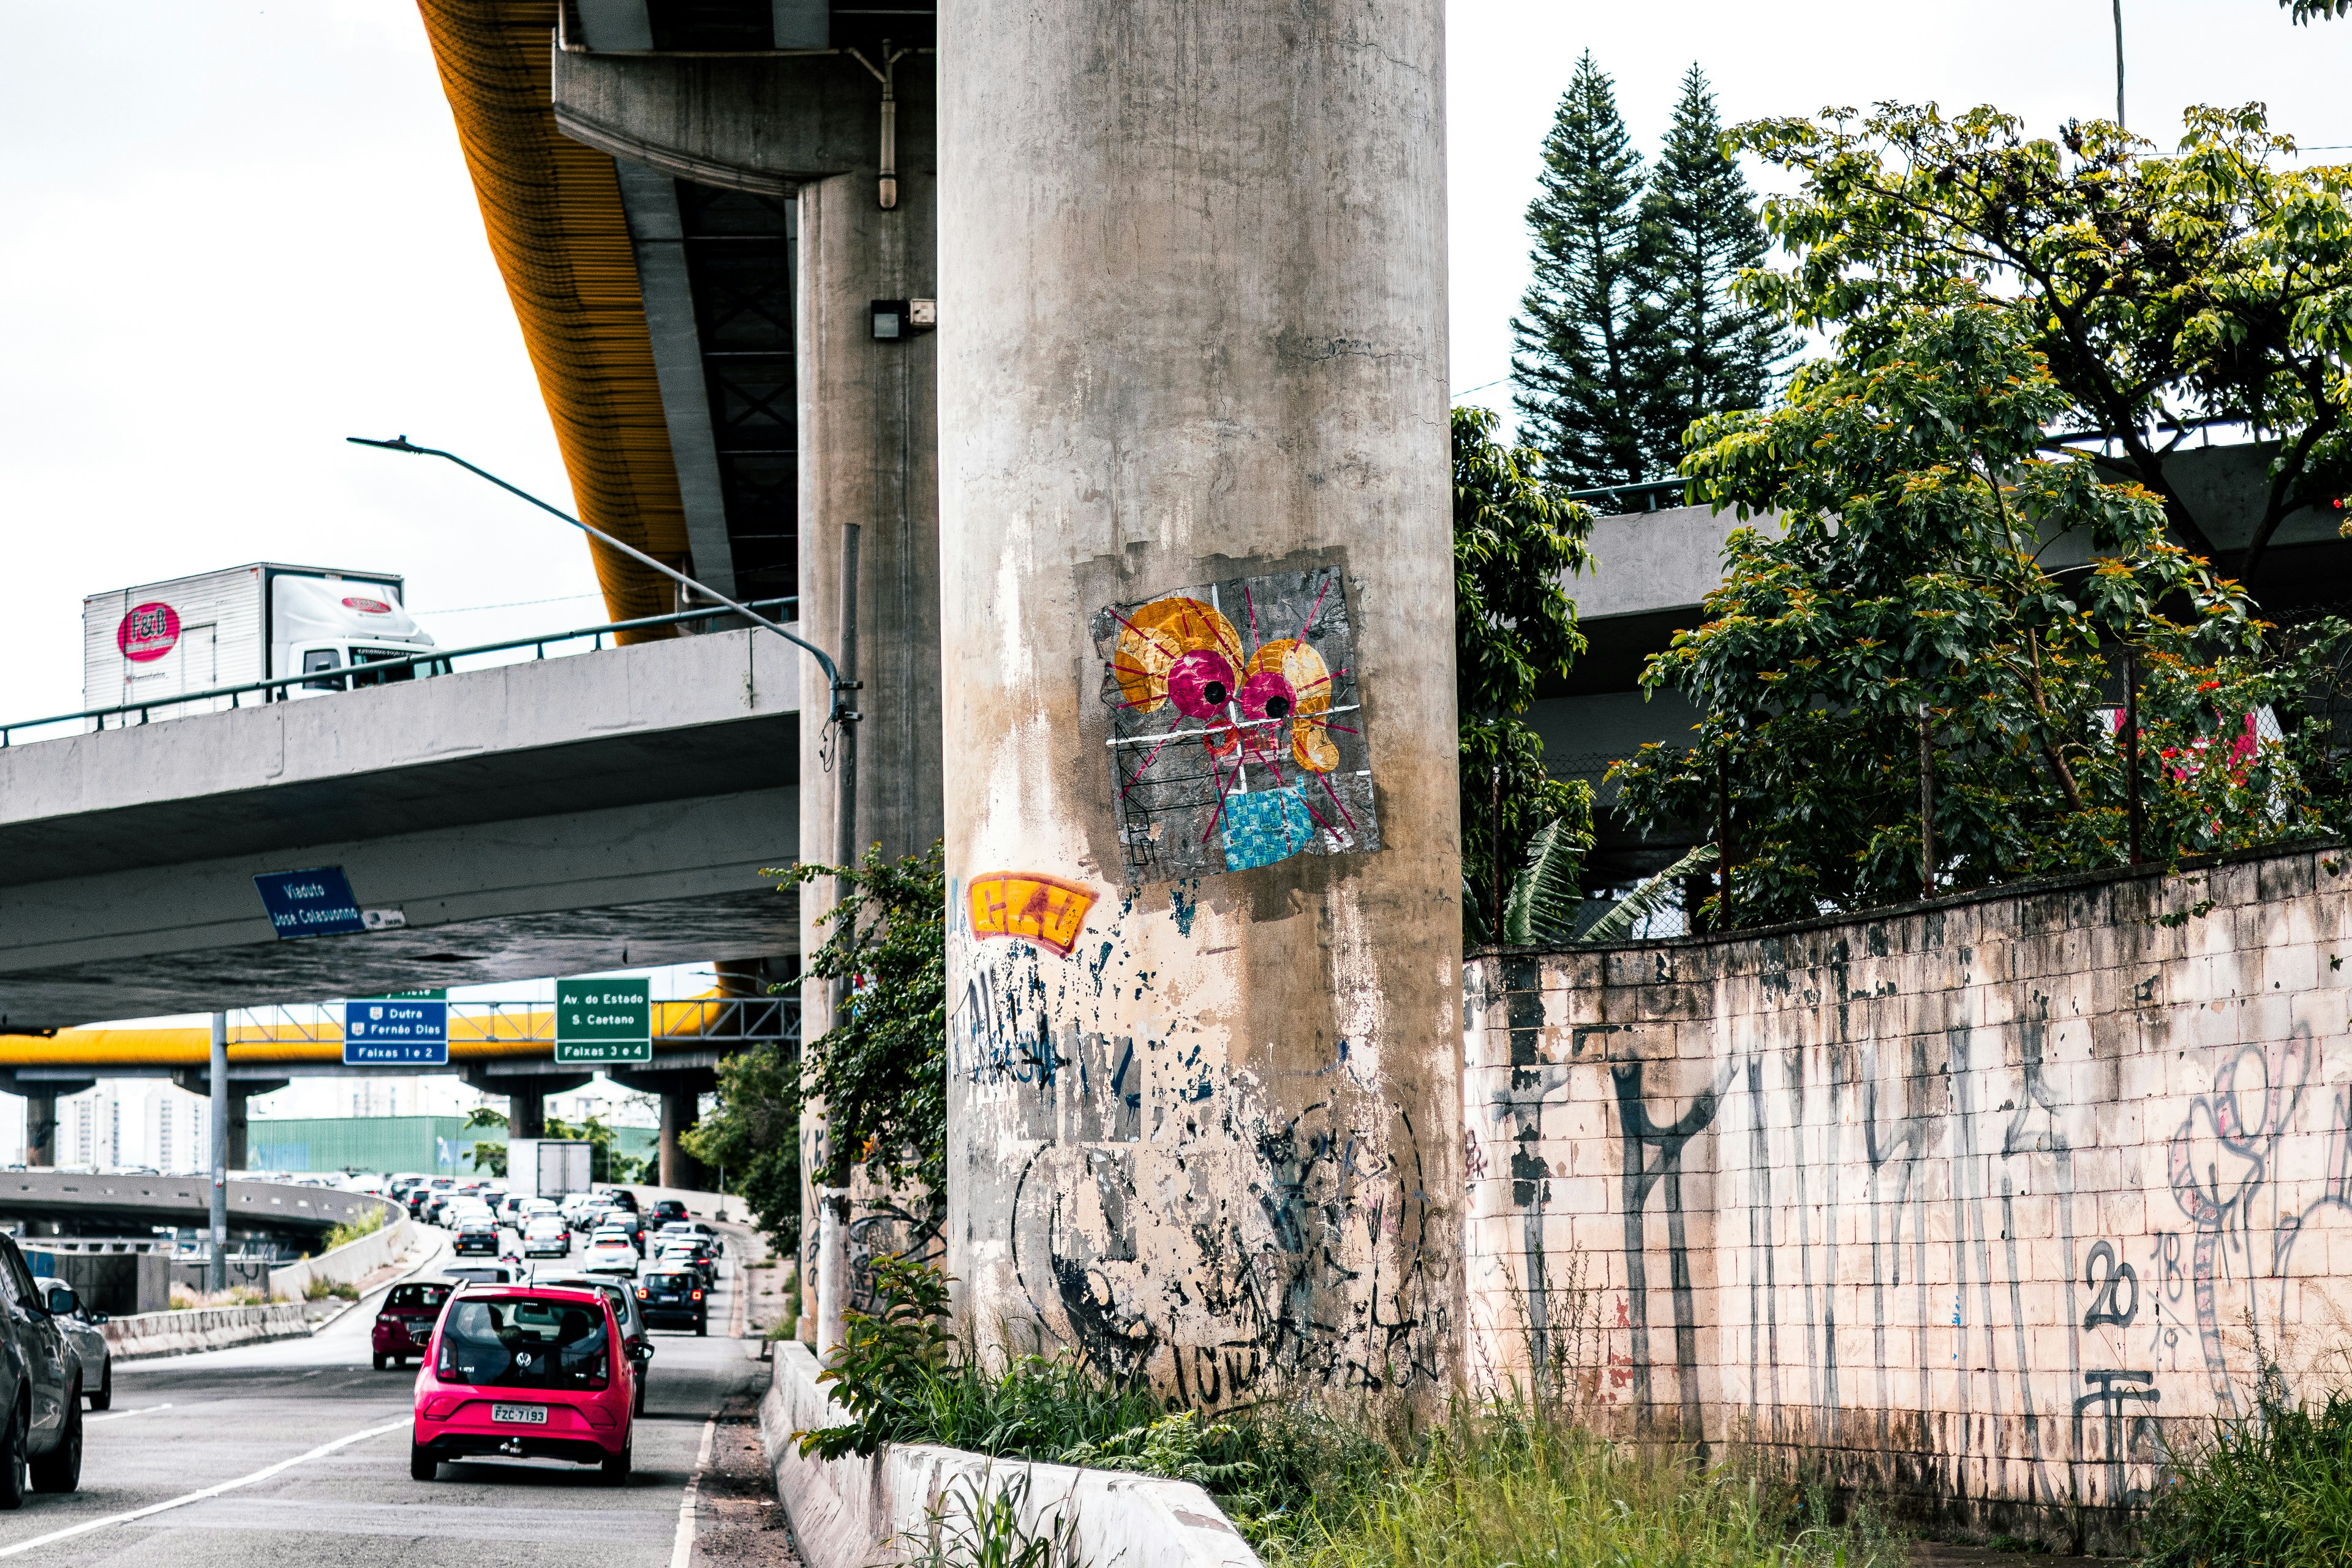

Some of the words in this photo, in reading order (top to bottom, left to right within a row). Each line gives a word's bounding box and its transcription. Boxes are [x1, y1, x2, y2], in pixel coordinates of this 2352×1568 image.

[284, 883, 325, 899] Viaduto
[275, 910, 297, 926] José
[299, 908, 357, 924] Colasuonno
[563, 994, 579, 1005] Av.
[586, 994, 598, 1005] do
[603, 994, 643, 1005] Estado
[390, 1009, 423, 1019] Dutra
[572, 1014, 582, 1025] S.
[587, 1014, 635, 1025] Caetano
[371, 1023, 410, 1035] Fernão
[416, 1024, 440, 1035] Dias
[359, 1048, 398, 1057] Faixas
[405, 1048, 409, 1057] 1
[426, 1048, 432, 1058] 2
[565, 1046, 604, 1057] Faixas
[611, 1046, 617, 1057] 3
[634, 1046, 641, 1056] 4
[2086, 1240, 2138, 1332] 20
